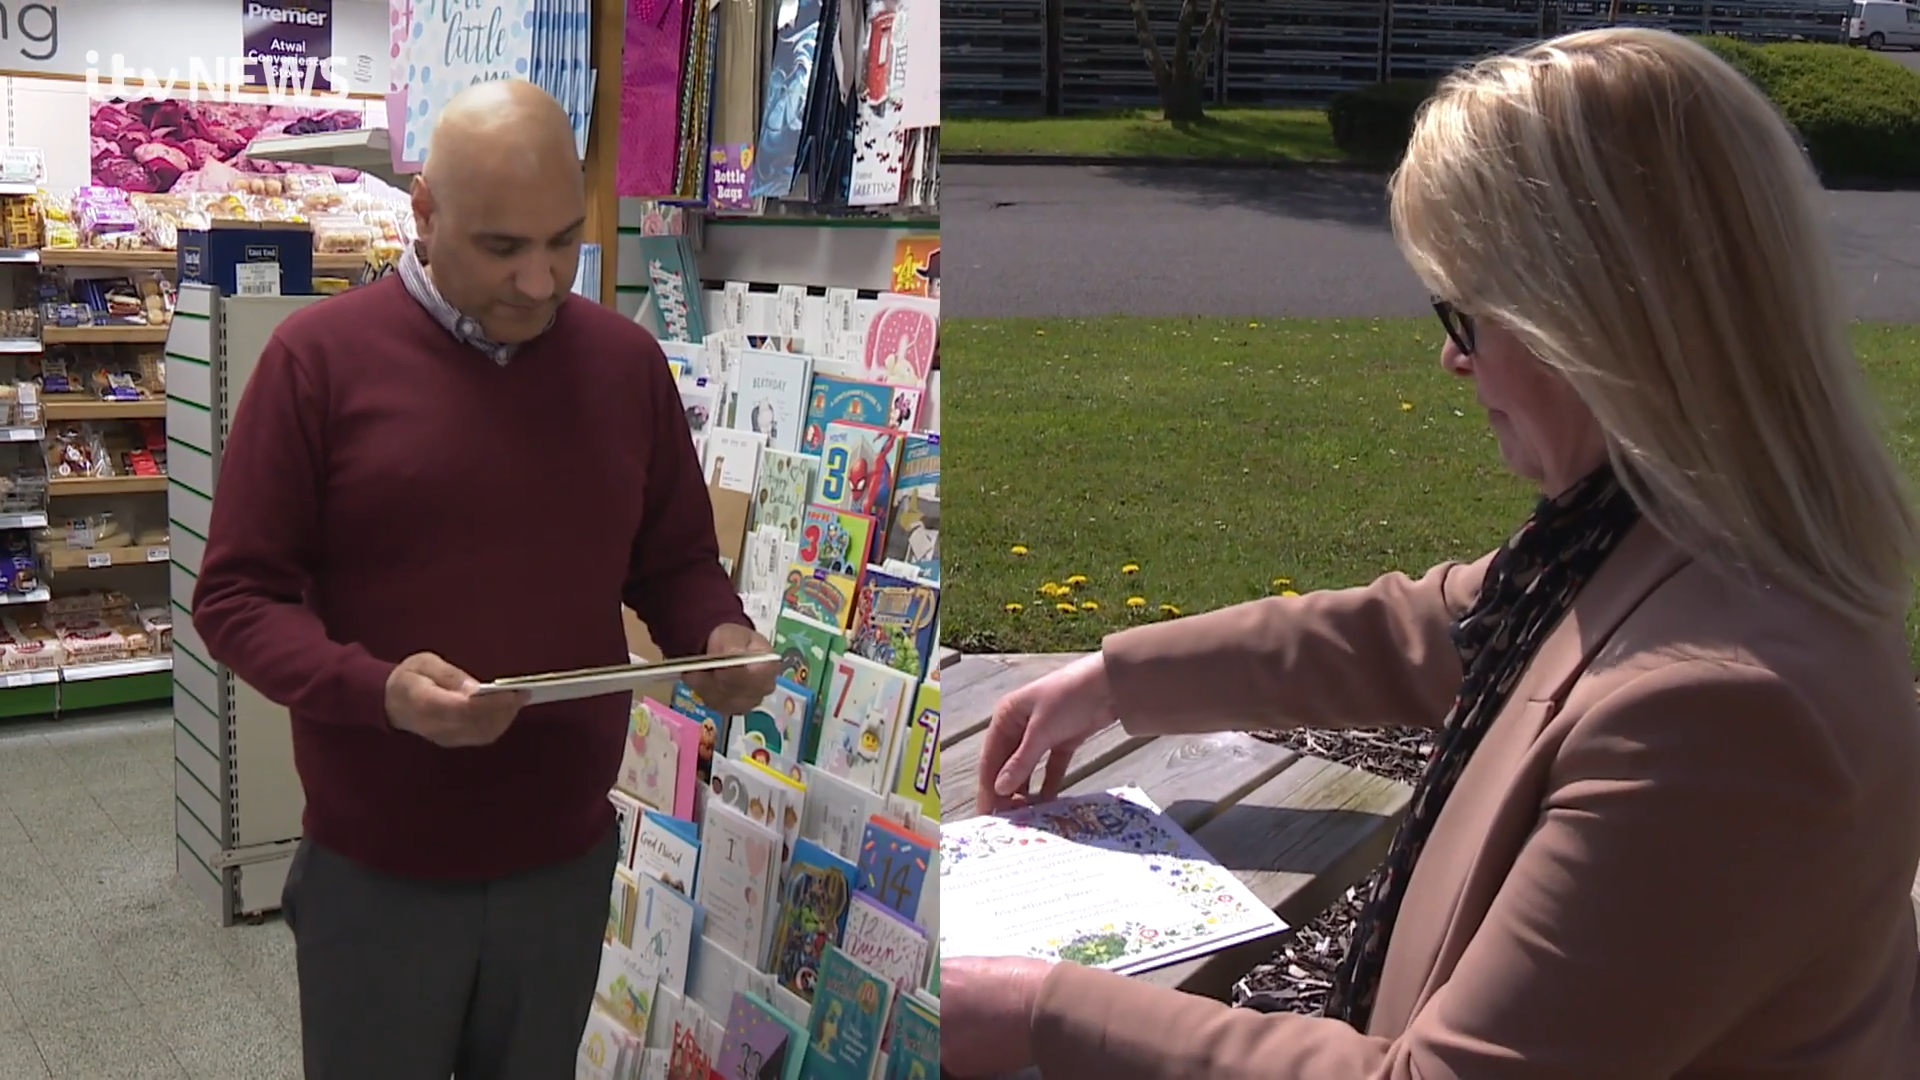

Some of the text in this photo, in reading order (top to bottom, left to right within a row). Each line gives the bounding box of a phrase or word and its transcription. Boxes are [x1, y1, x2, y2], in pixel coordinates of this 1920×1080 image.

[248, 3, 327, 26] Premier
[270, 38, 306, 53] Atwal
[445, 6, 507, 67] little
[714, 169, 746, 184] Bottle
[717, 185, 743, 203] Bags
[823, 447, 848, 501] 3
[801, 525, 820, 563] 3
[833, 663, 855, 719] 7
